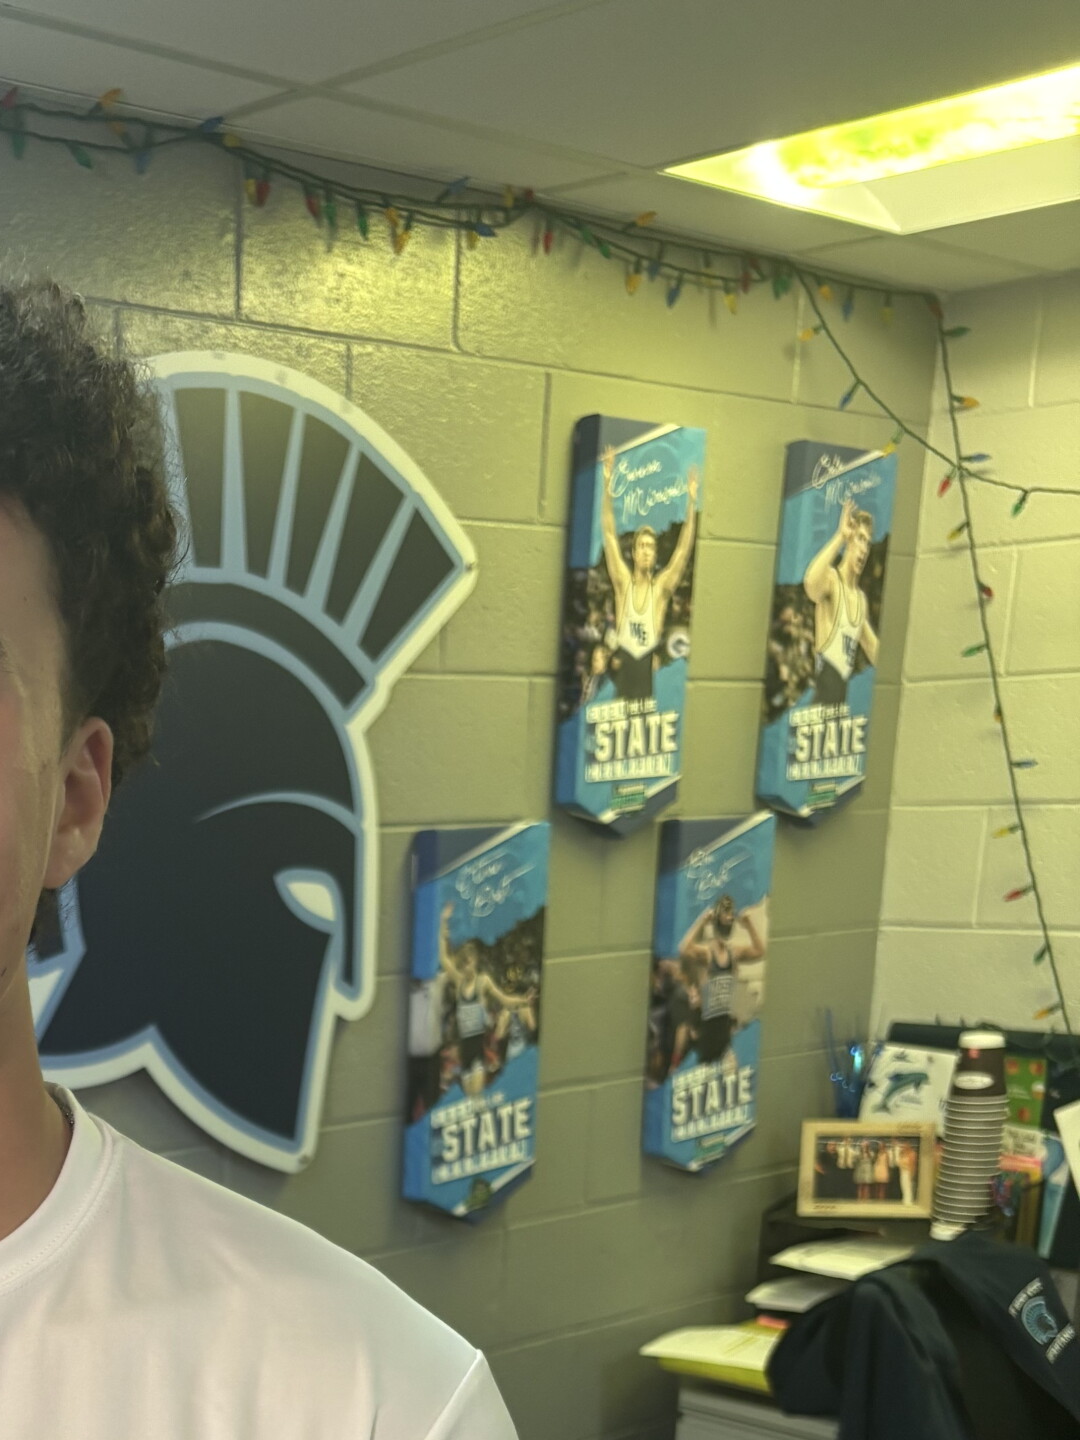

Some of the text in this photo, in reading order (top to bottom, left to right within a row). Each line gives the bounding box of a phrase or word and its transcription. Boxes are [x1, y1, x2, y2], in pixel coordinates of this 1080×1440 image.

[594, 710, 680, 762] STATE
[795, 715, 869, 763] STATE
[672, 1064, 755, 1125] STATE
[441, 1097, 533, 1162] STATE
